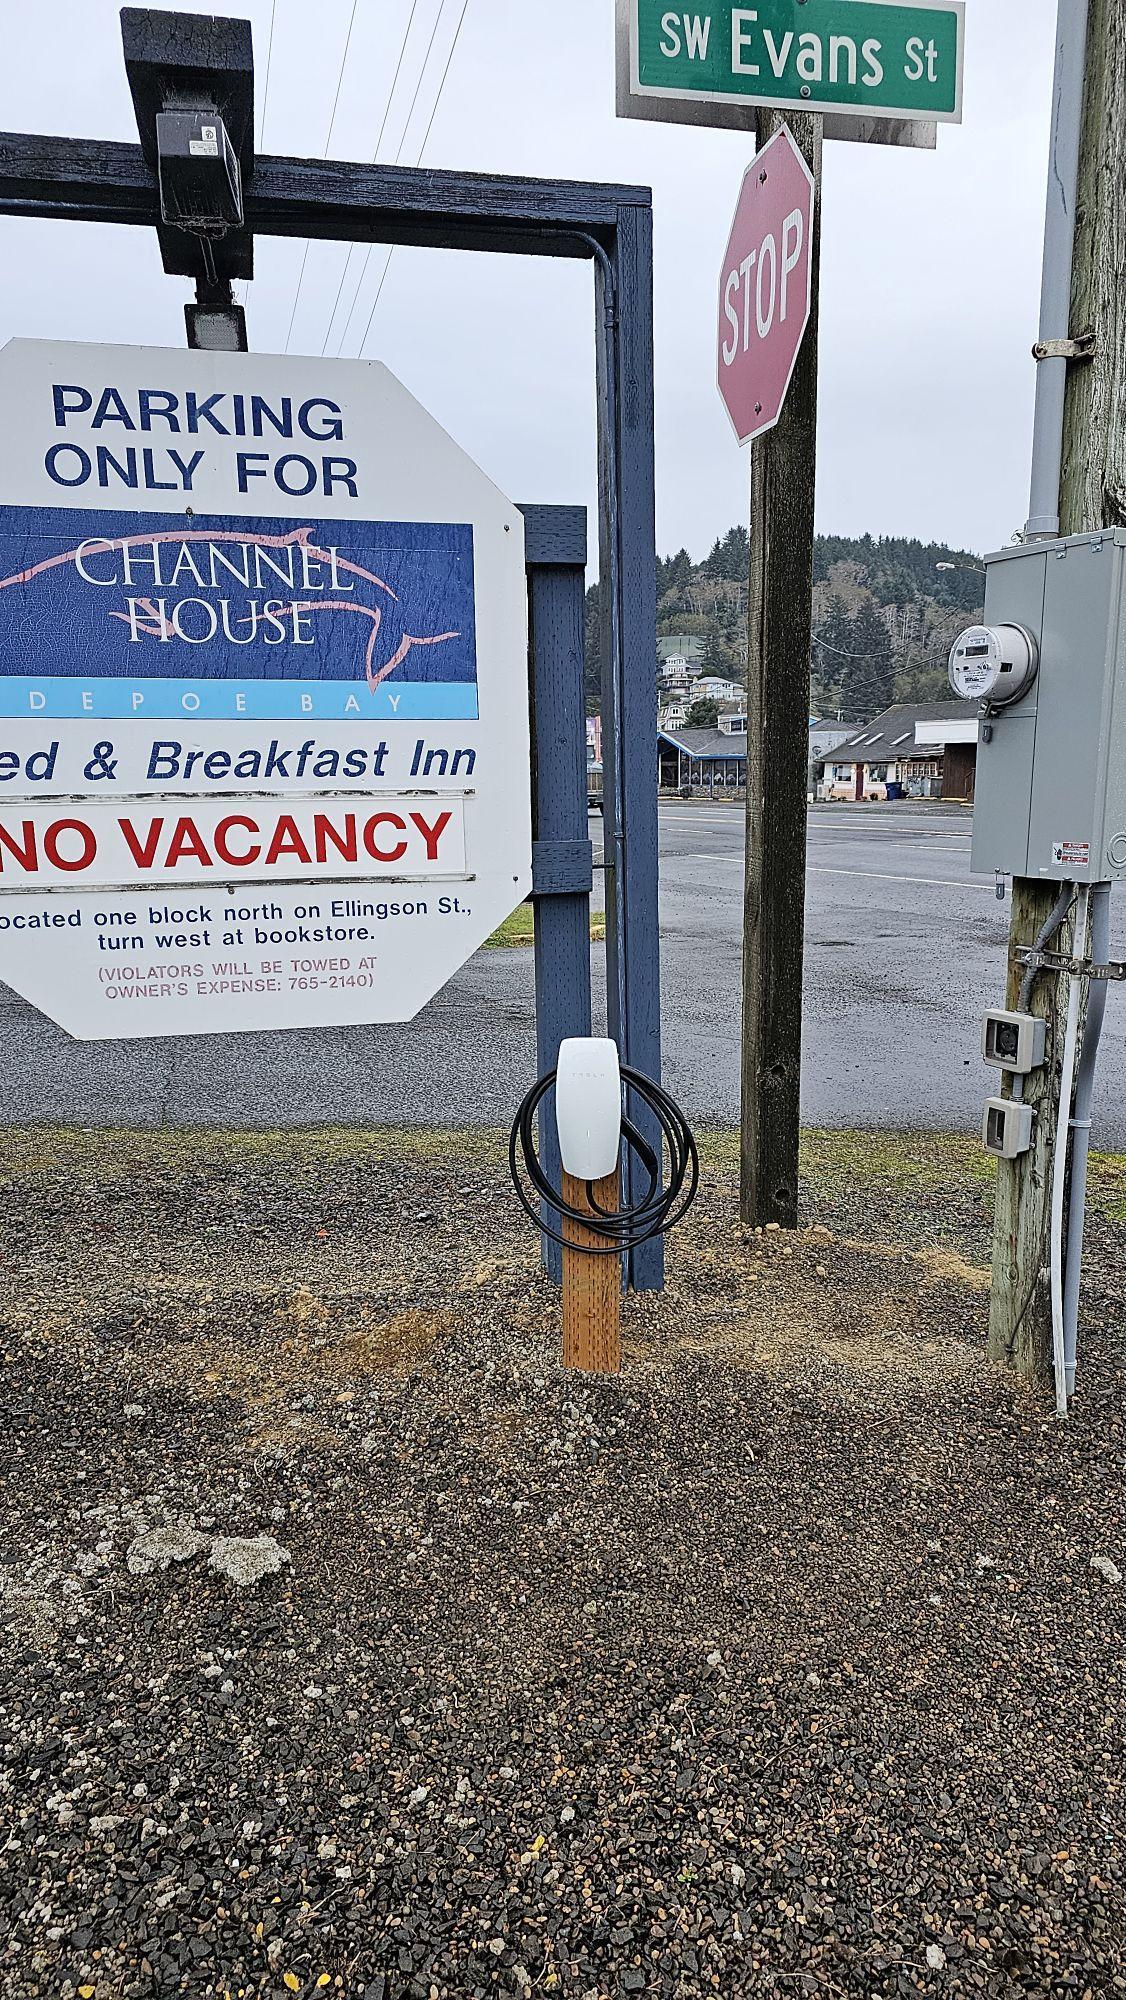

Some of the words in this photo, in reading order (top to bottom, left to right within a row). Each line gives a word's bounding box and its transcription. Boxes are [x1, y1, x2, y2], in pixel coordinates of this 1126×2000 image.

[659, 12, 711, 60] SW
[731, 8, 884, 87] Evans
[904, 37, 938, 82] St
[721, 208, 804, 367] STOP
[52, 384, 345, 441] PARKING
[44, 443, 205, 490] ONLY
[236, 453, 359, 497] FOR
[75, 538, 354, 591] CHANNEL
[126, 597, 316, 645] HOUSE
[29, 691, 247, 712] DEPOE
[301, 692, 402, 712] BAY
[84, 740, 118, 781] &
[146, 740, 389, 780] Breakfast
[409, 739, 477, 776] Inn
[0, 818, 97, 872] NO
[117, 811, 453, 868] VACANCY
[94, 911, 137, 926] one
[149, 905, 212, 925] block
[224, 903, 282, 921] north
[294, 905, 320, 919] on
[331, 899, 428, 920] Ellingson
[438, 896, 472, 917] St.,
[98, 934, 144, 950] turn
[155, 930, 211, 948] west
[222, 929, 244, 946] at
[255, 925, 376, 945] bookstore.
[98, 963, 204, 983] (VIOLATORS
[212, 961, 253, 976] WILL
[261, 960, 283, 974] BE
[291, 958, 350, 972] TOWED
[358, 957, 378, 970] AT
[105, 983, 188, 999] OWNER'S
[197, 978, 281, 995] EXPENSE:
[288, 973, 374, 990] 765-2140)
